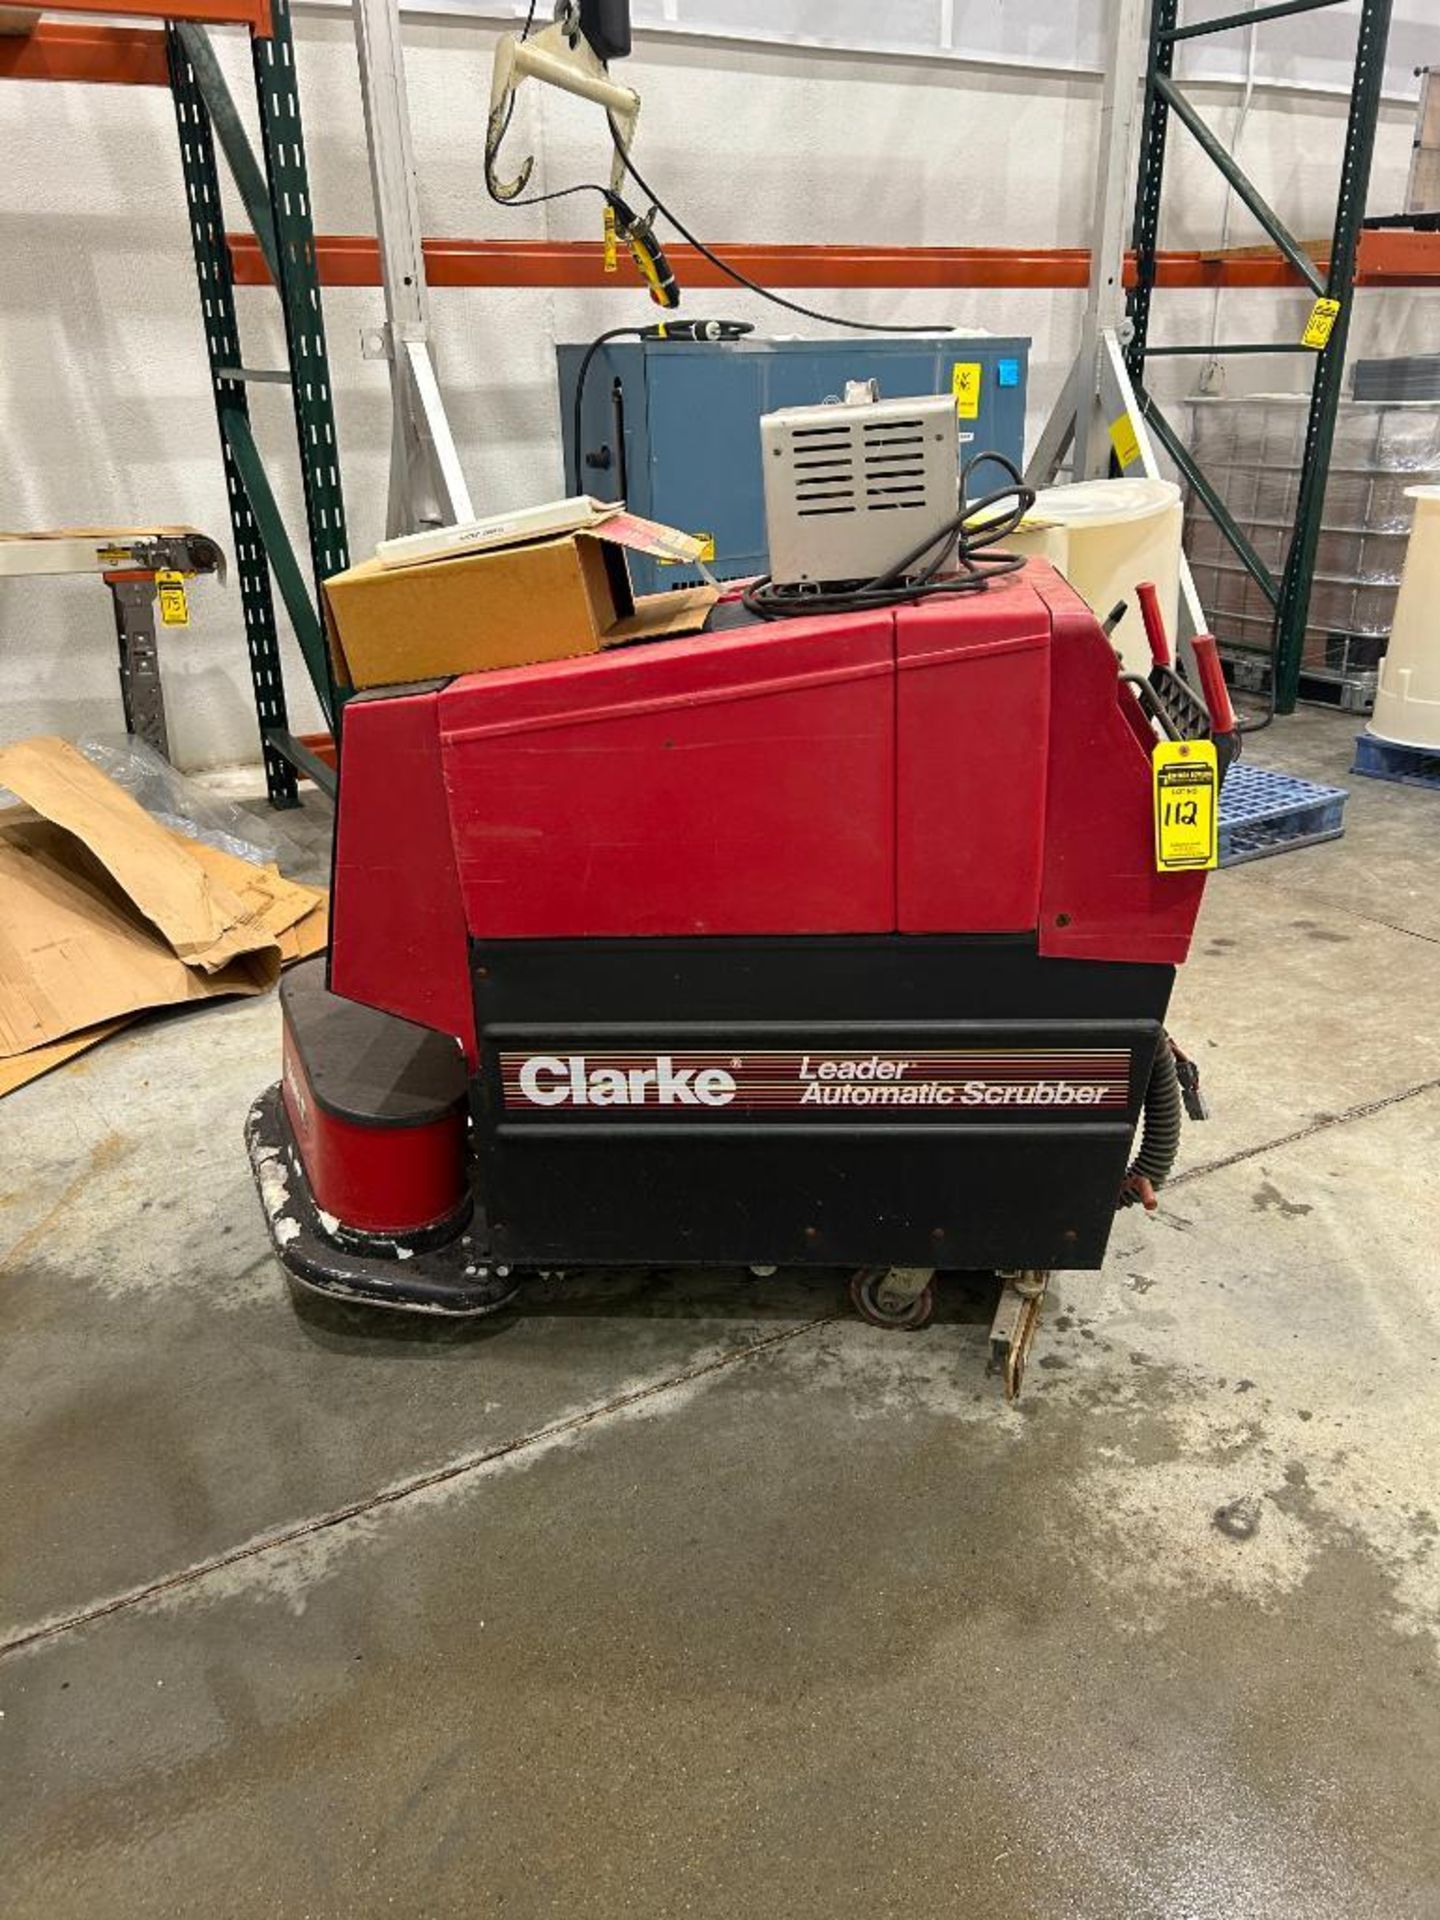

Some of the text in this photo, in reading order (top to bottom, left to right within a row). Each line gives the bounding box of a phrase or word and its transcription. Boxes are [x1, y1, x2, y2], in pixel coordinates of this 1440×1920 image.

[1164, 801, 1198, 827] 112
[798, 1056, 908, 1080] Leader
[519, 1056, 737, 1106] Clarke
[800, 1081, 1109, 1105] Automatic Scrubber
